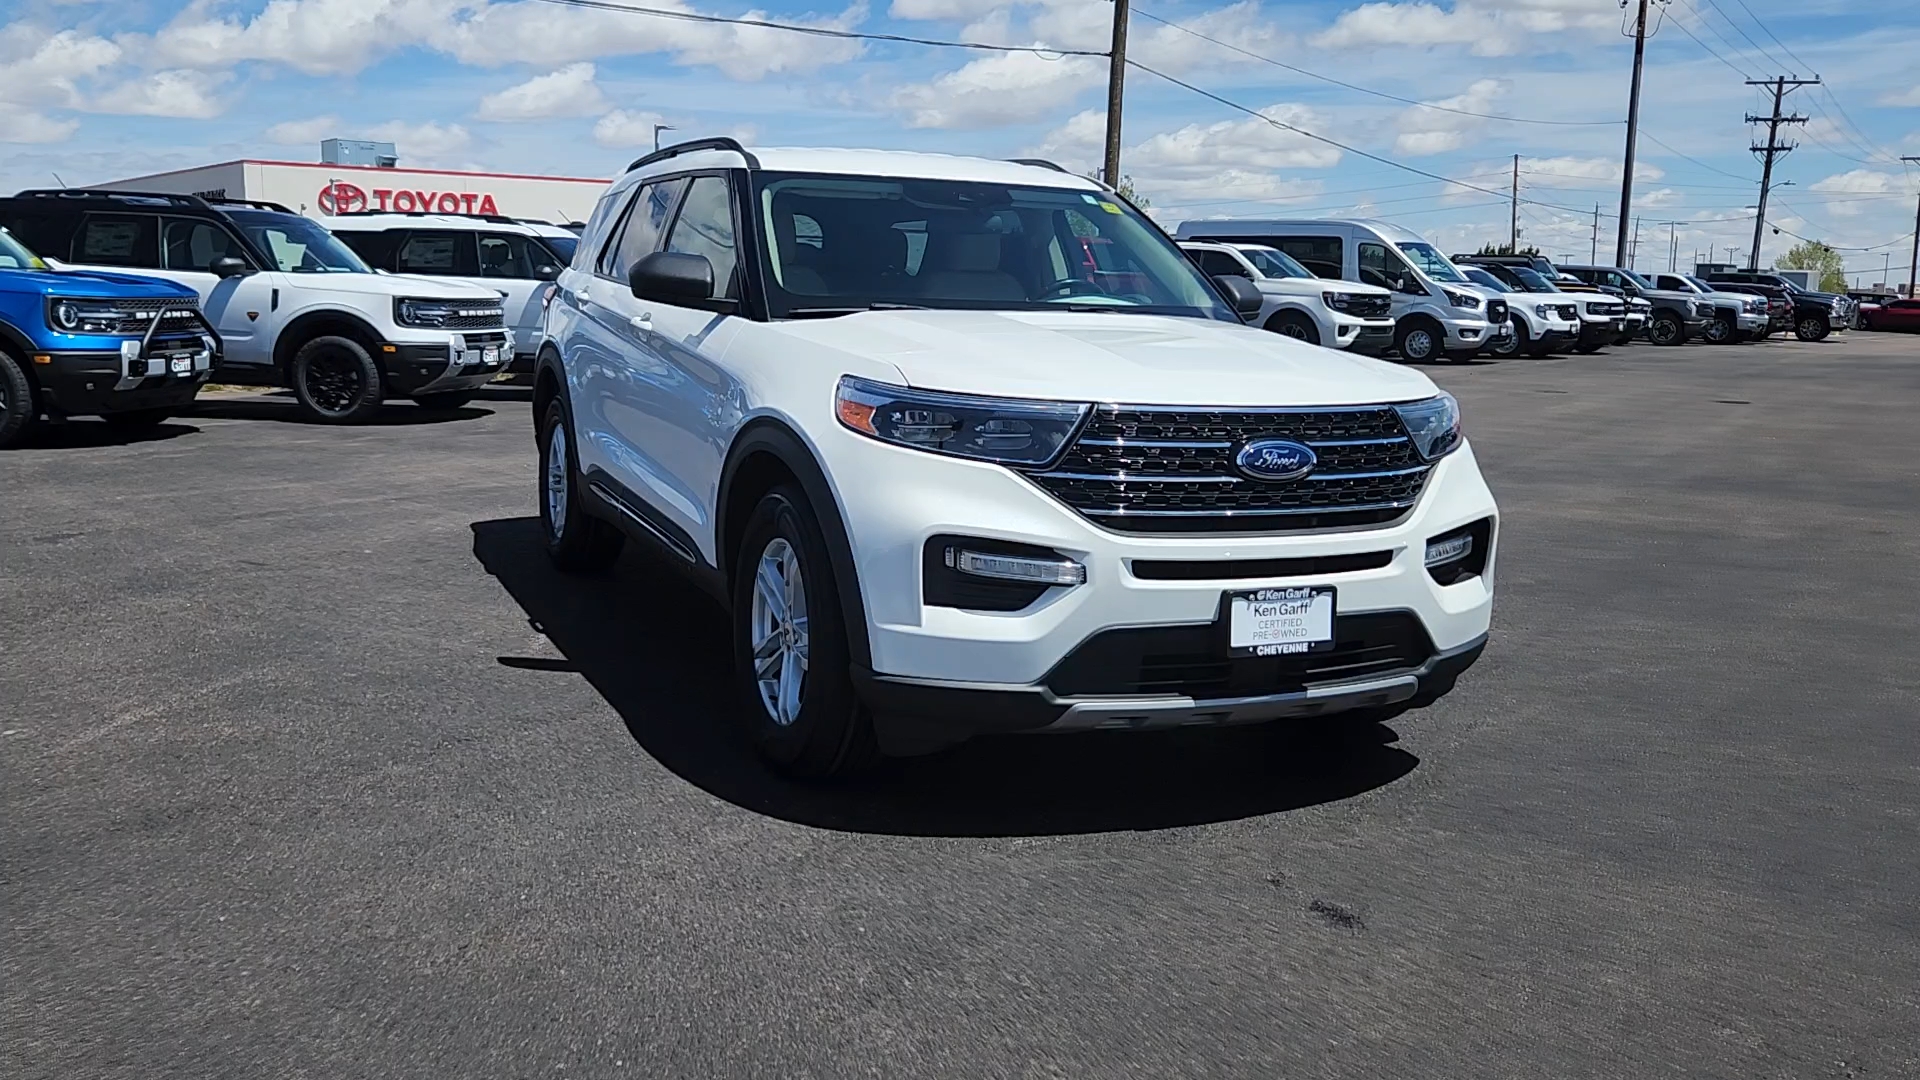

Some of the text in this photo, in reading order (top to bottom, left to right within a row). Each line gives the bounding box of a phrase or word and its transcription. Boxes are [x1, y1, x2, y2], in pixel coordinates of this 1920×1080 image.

[372, 189, 499, 216] TOYOTA
[1254, 448, 1300, 469] Ford
[1265, 588, 1310, 600] Ken Garff
[1253, 601, 1309, 617] Ken Garff
[1258, 618, 1303, 629] CERTIFIED
[1256, 642, 1309, 656] CHEYENNE
